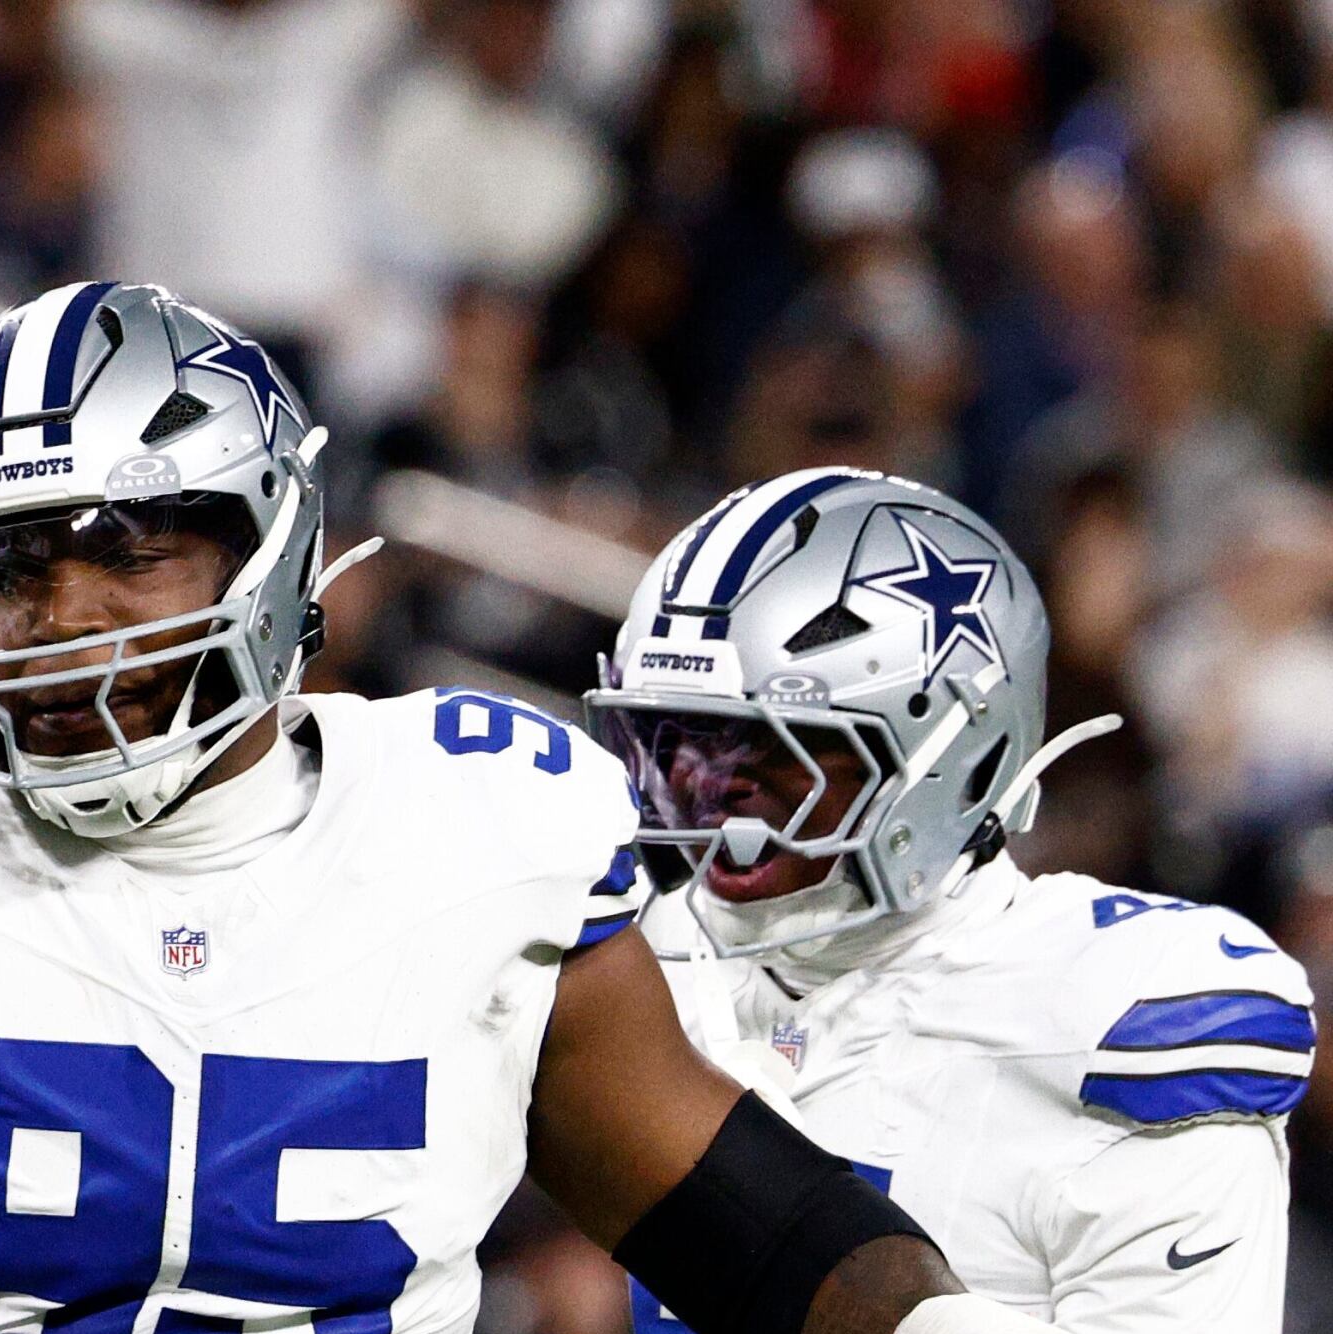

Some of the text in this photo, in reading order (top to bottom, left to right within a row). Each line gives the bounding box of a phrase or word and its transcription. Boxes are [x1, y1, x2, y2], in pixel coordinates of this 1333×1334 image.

[111, 474, 177, 489] OAKLEY
[641, 653, 715, 672] COWBOYS
[168, 945, 203, 968] NFL
